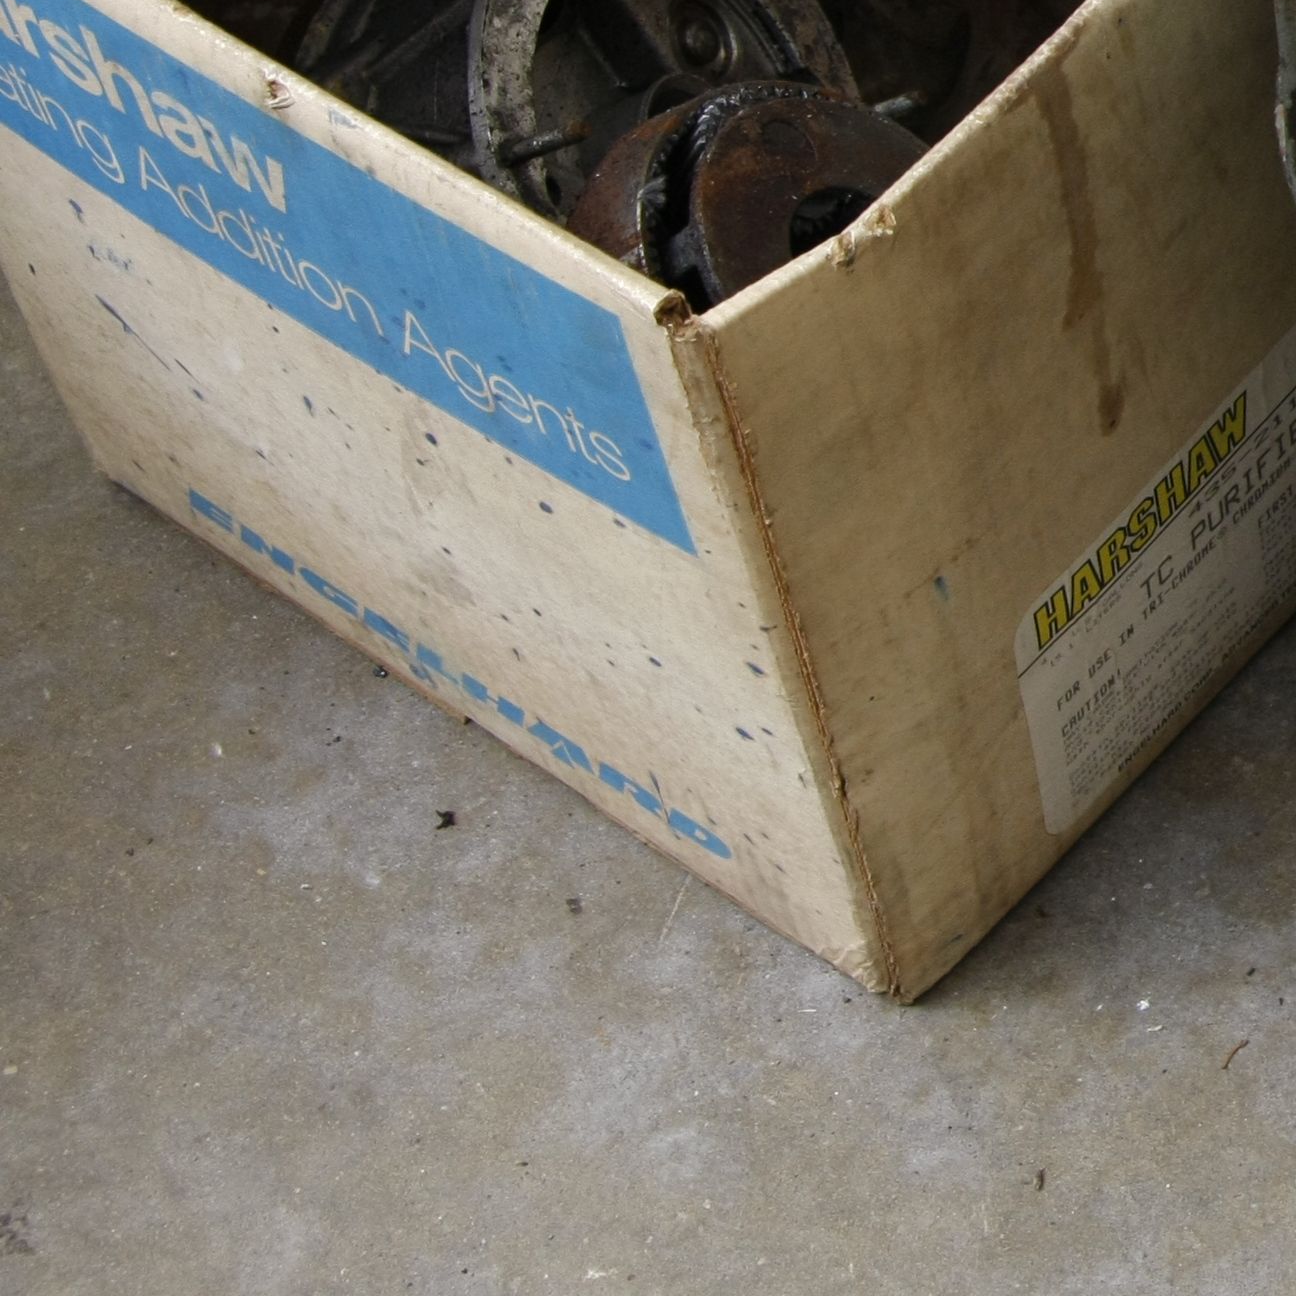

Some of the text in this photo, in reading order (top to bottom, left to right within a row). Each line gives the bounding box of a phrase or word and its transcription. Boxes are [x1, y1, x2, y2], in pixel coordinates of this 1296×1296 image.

[138, 145, 386, 338] Addition
[402, 312, 632, 484] Agents
[1032, 388, 1248, 653] HARSHAW
[1137, 554, 1176, 601] TC
[188, 487, 734, 861] ENGELHARD
[1056, 679, 1082, 711] FOR
[1087, 647, 1113, 679] USE
[1117, 623, 1136, 648] IN
